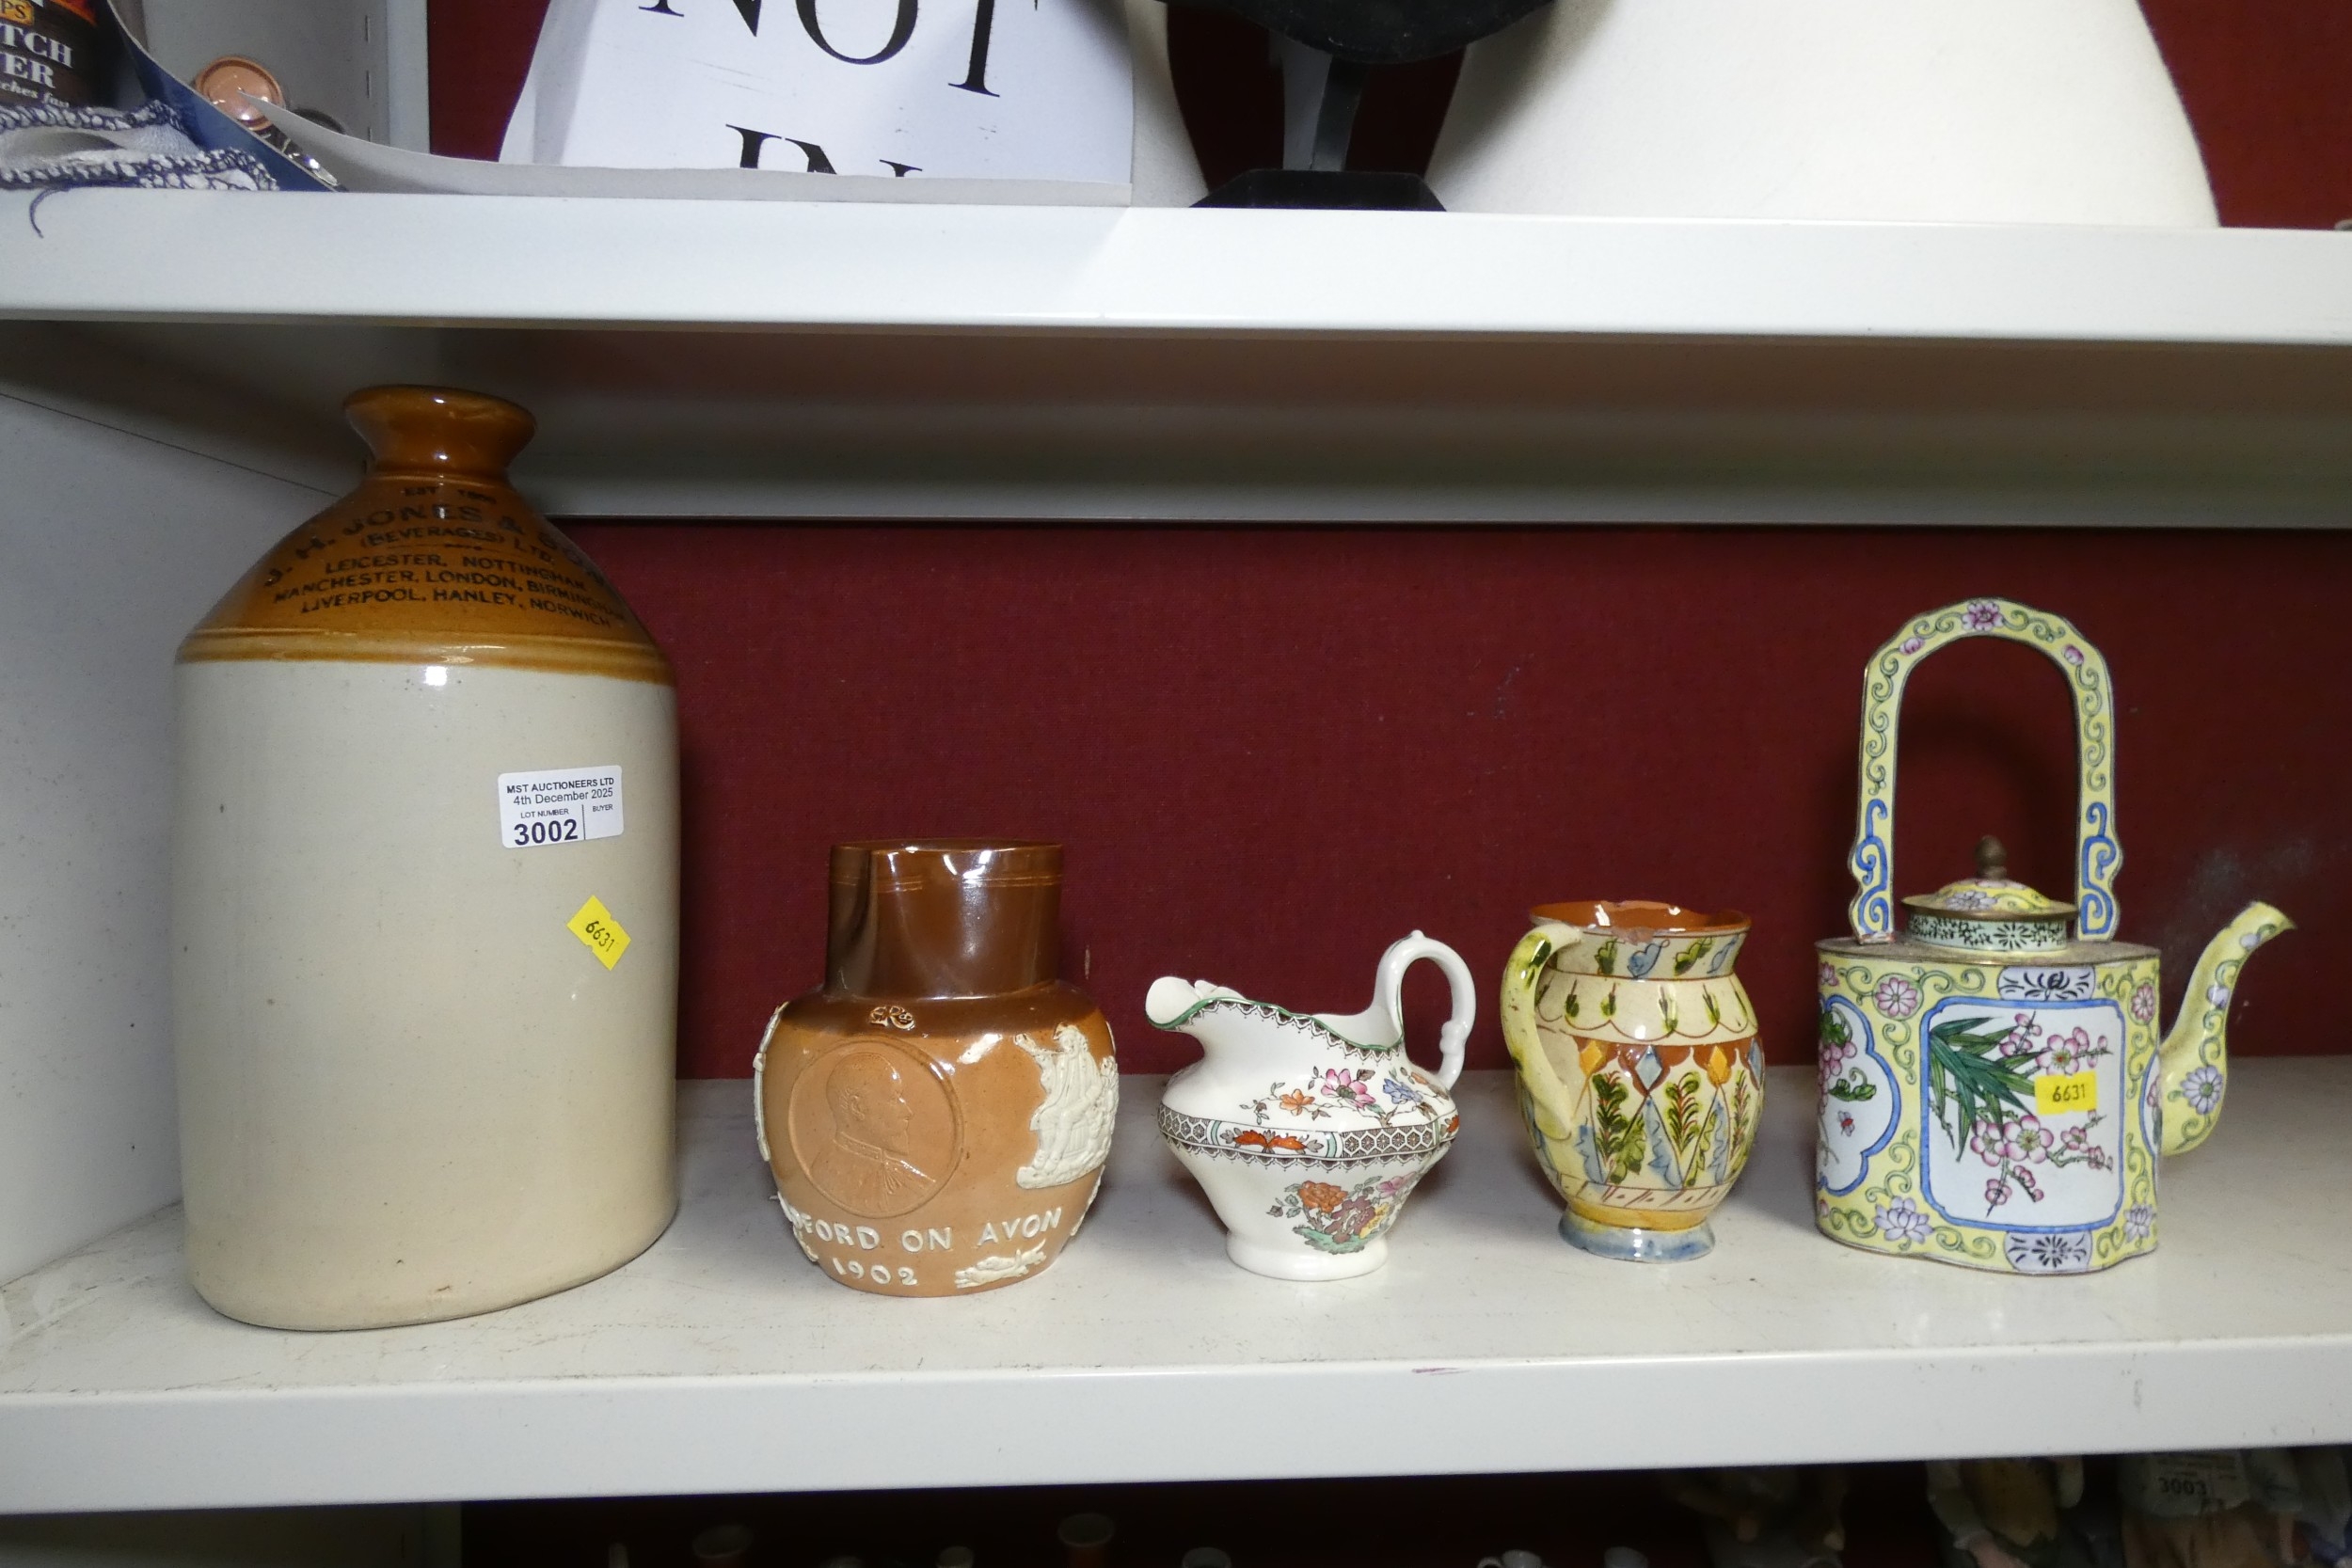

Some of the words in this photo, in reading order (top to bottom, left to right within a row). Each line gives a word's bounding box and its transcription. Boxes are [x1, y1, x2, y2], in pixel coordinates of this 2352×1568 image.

[342, 504, 482, 536] JONES
[360, 525, 504, 548] (BEVERAGES)
[530, 597, 611, 627] NORWICH
[506, 784, 529, 794] MST
[532, 779, 598, 792] AUCTIONEERS
[599, 777, 614, 786] LTD
[513, 795, 532, 805] 4th
[535, 791, 589, 804] December
[591, 787, 613, 800] 2025
[537, 808, 569, 817] NUMBER
[592, 804, 613, 813] BUYER
[514, 818, 579, 846] 3002
[585, 920, 615, 952] 6631
[2053, 1084, 2085, 1102] 6631
[901, 1227, 953, 1253] ON
[977, 1207, 1063, 1247] AVON
[833, 1257, 918, 1286] 1902
